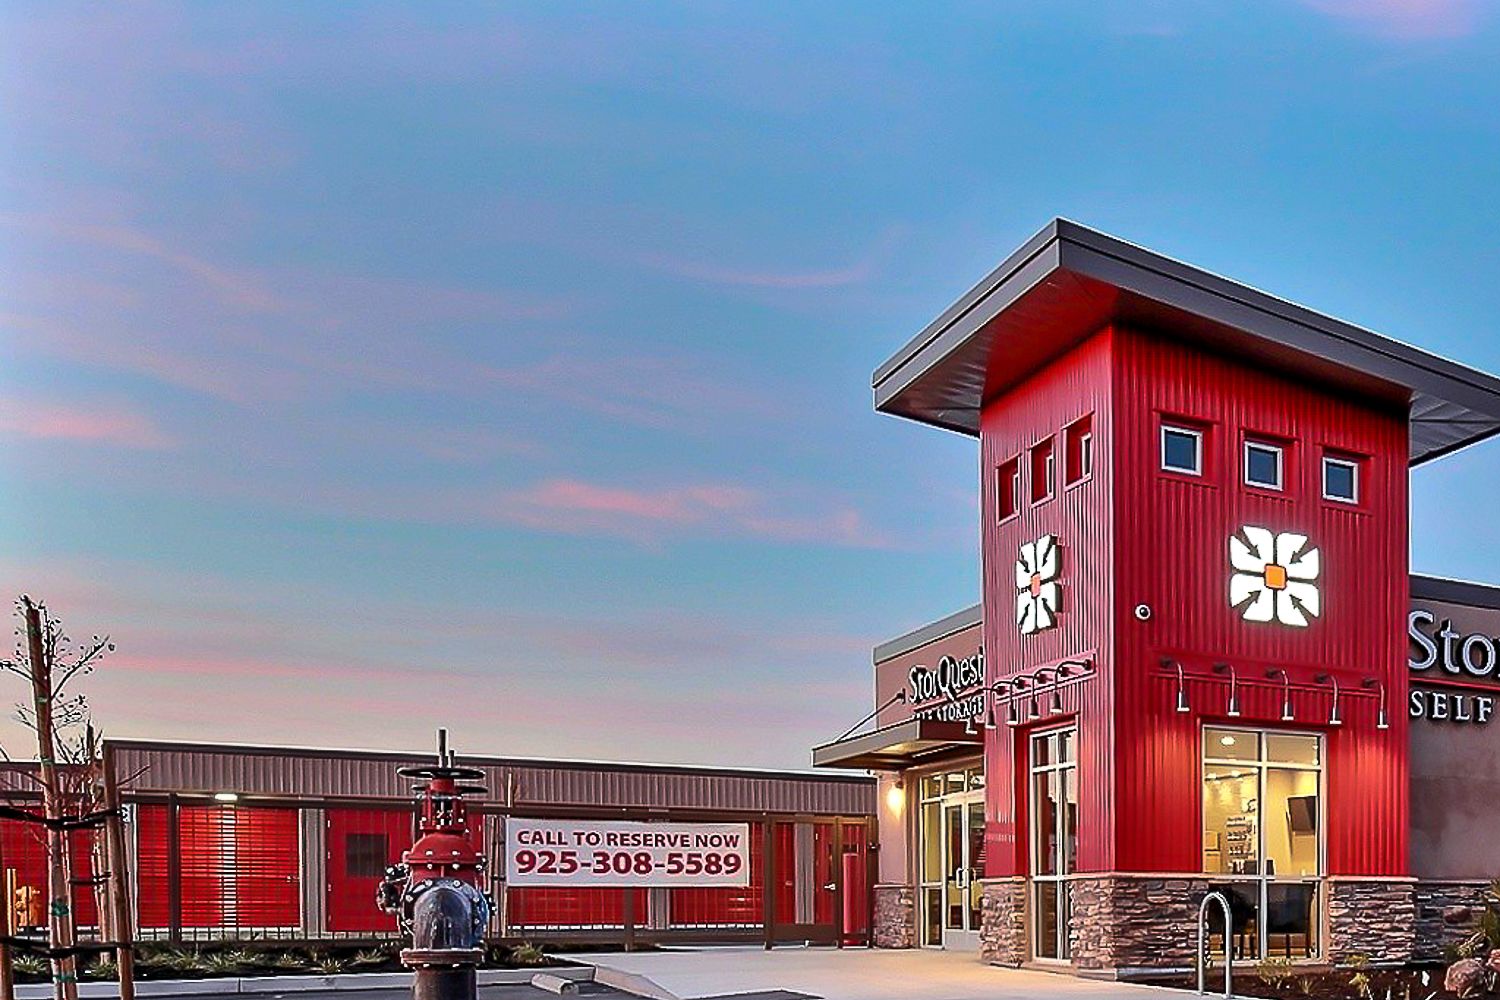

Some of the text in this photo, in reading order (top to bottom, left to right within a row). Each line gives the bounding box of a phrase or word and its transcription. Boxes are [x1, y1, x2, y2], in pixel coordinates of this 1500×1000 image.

[909, 653, 983, 703] StorQuest
[1410, 690, 1493, 722] SELF
[517, 830, 740, 848] CALL TO RESERVE NOW
[516, 850, 742, 875] 925-308-5589
